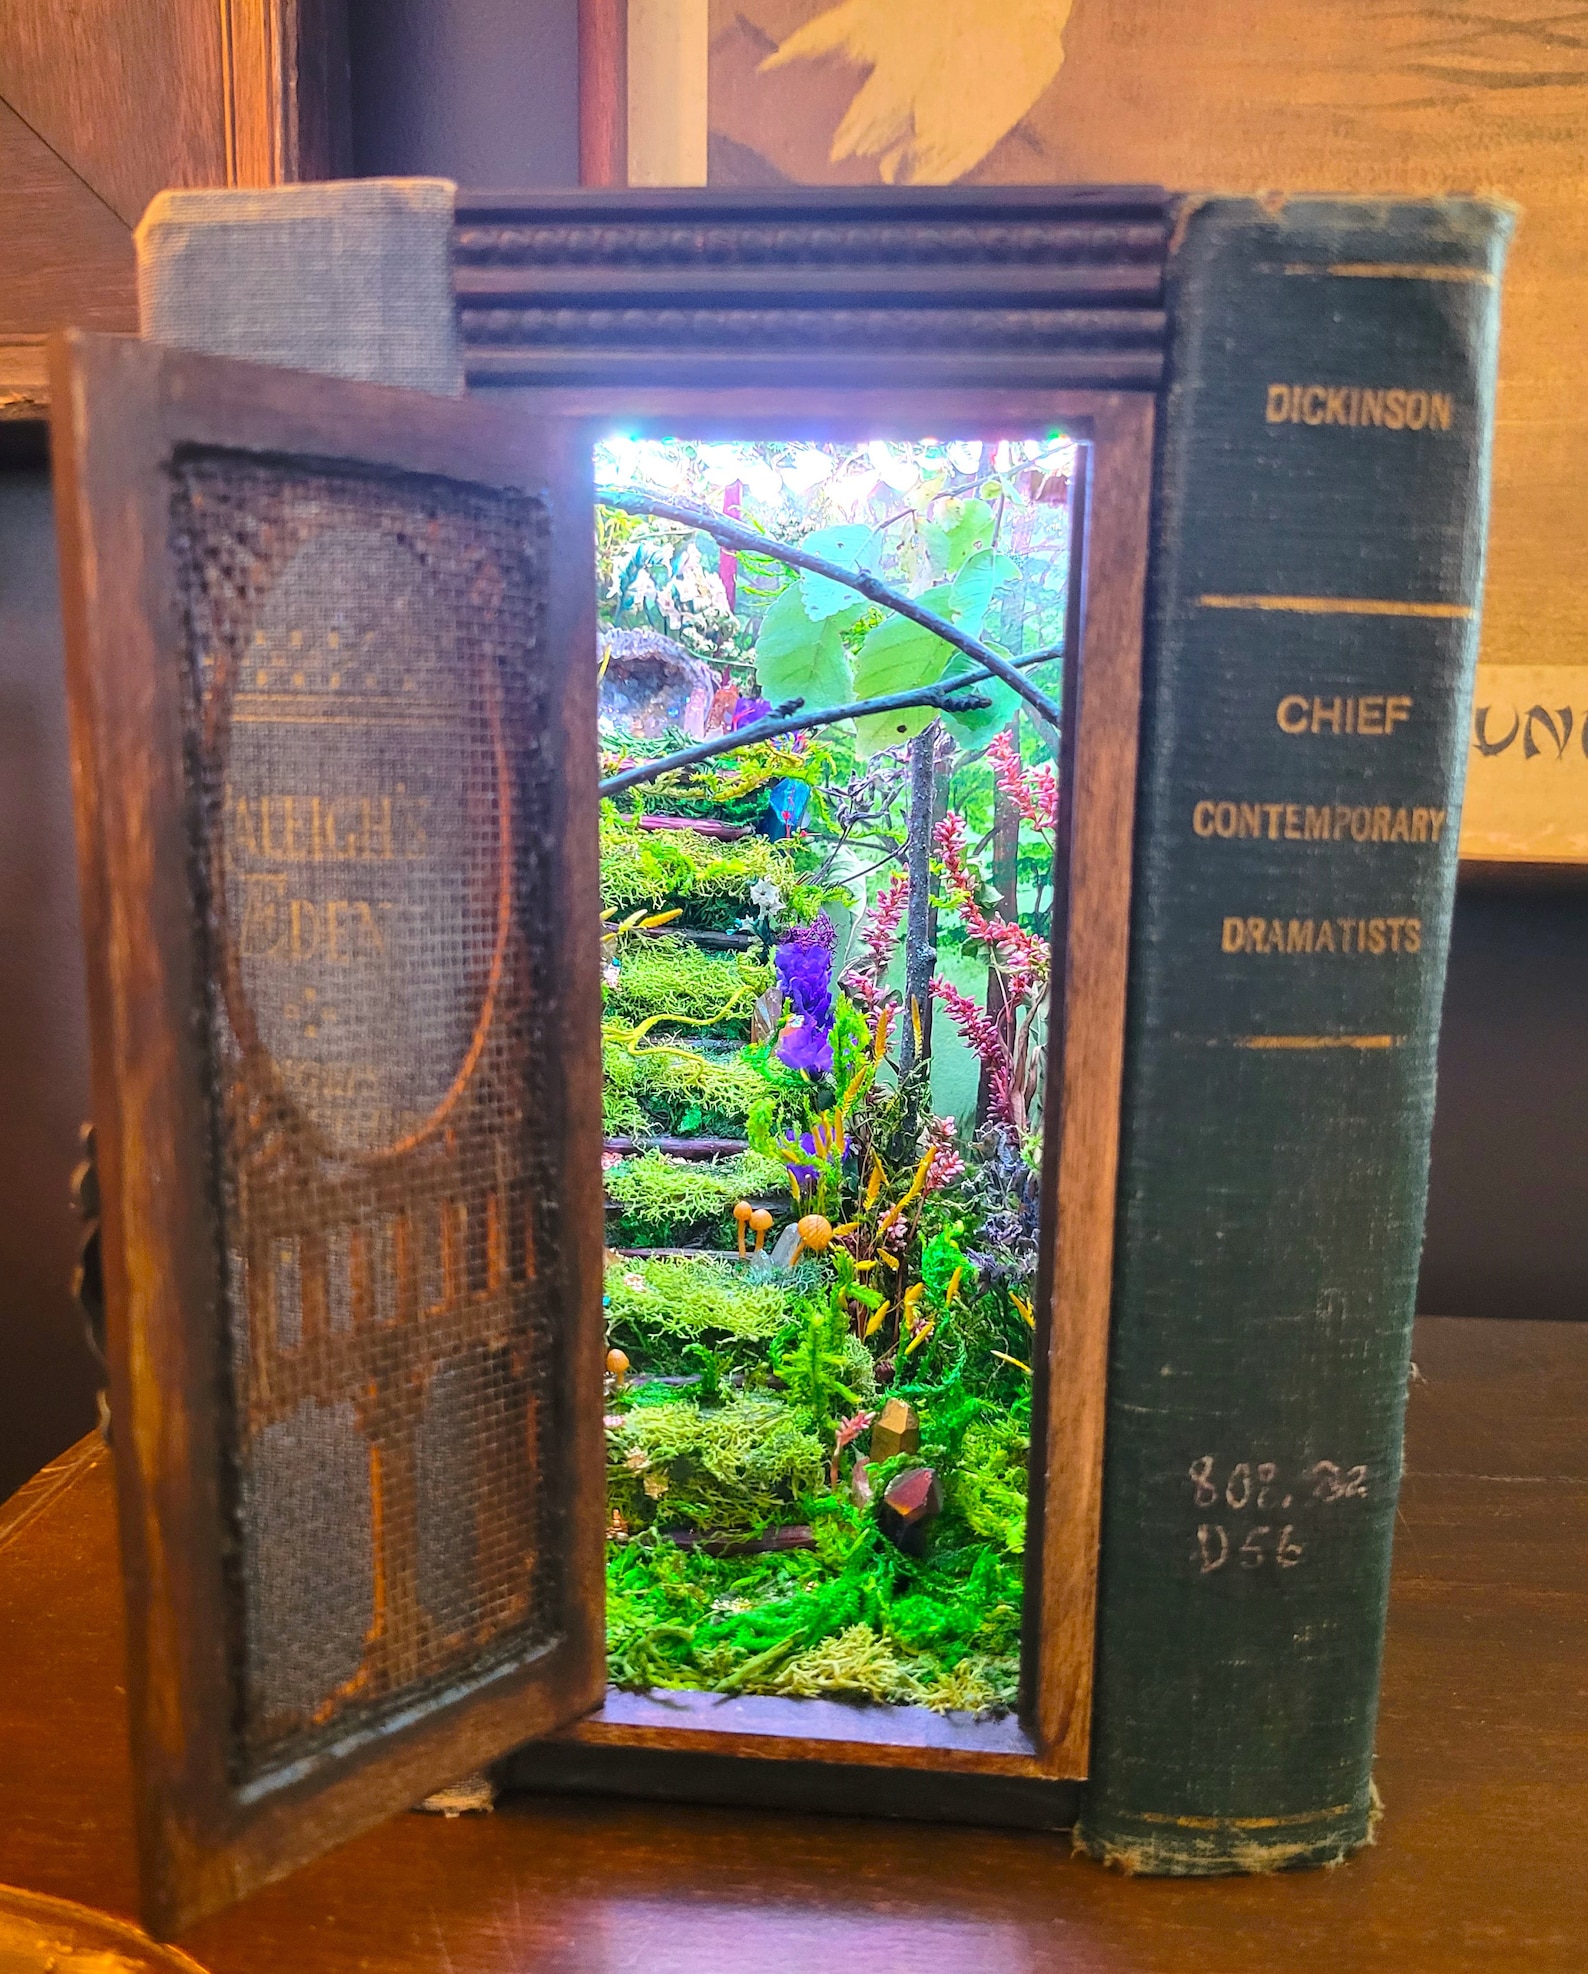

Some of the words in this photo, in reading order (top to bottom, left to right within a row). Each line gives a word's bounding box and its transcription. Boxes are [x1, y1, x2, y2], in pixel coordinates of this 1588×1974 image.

[1265, 384, 1453, 431] DICKINSON
[1276, 695, 1413, 736] CHIEF
[1473, 704, 1588, 761] UN
[1193, 800, 1446, 842] CONTEMPORARY
[1221, 916, 1422, 955] DRAMATISTS
